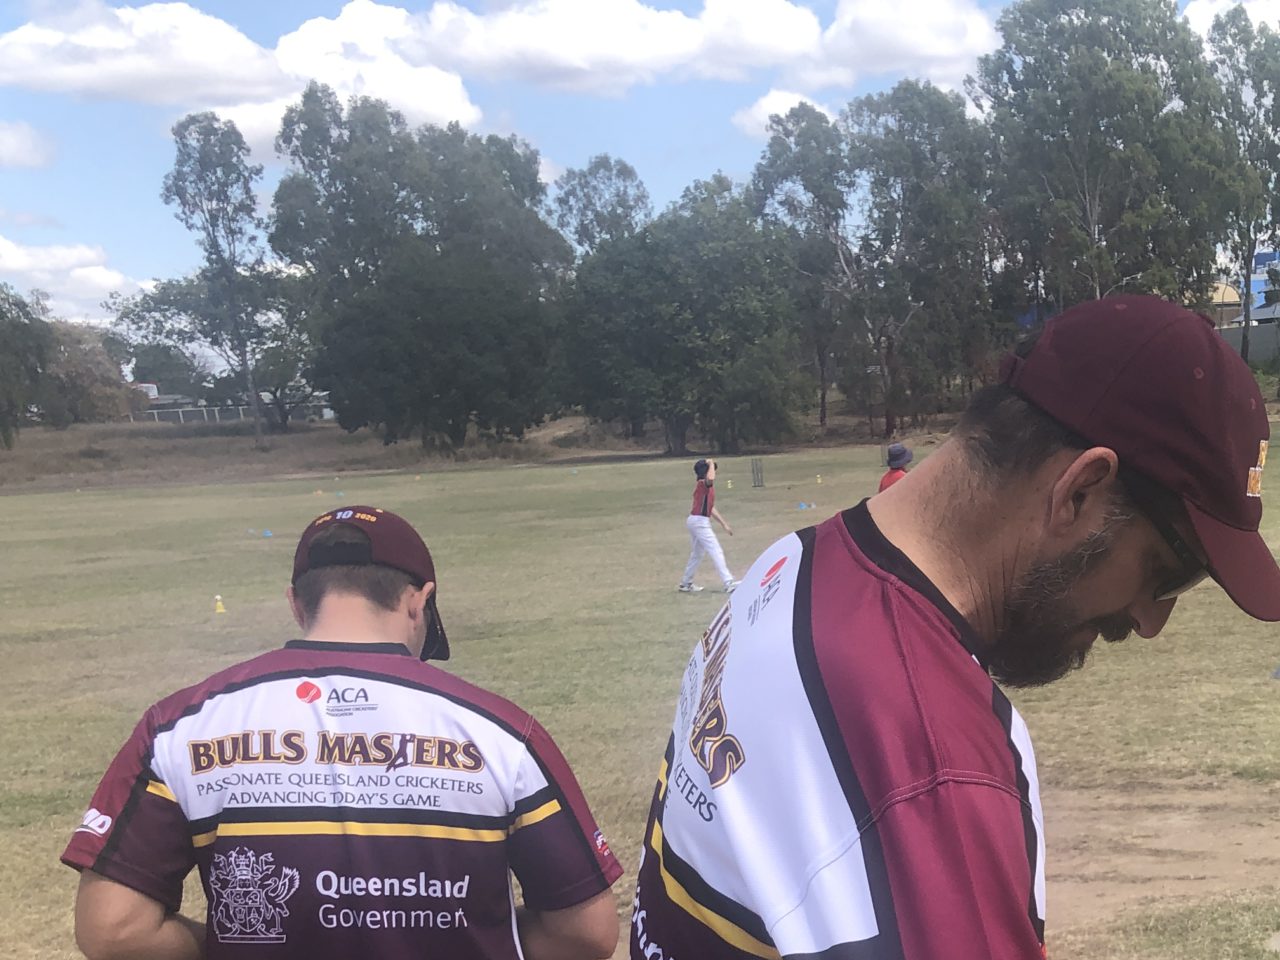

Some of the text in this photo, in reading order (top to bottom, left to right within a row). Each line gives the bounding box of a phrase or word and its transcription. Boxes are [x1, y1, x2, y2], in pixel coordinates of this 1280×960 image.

[326, 687, 369, 704] ACA
[187, 729, 485, 775] BULLS MASTERS
[196, 773, 283, 796] PASSONATE
[394, 775, 484, 795] CRICKETERS
[227, 791, 327, 805] ADVANCING
[393, 793, 441, 807] GAME
